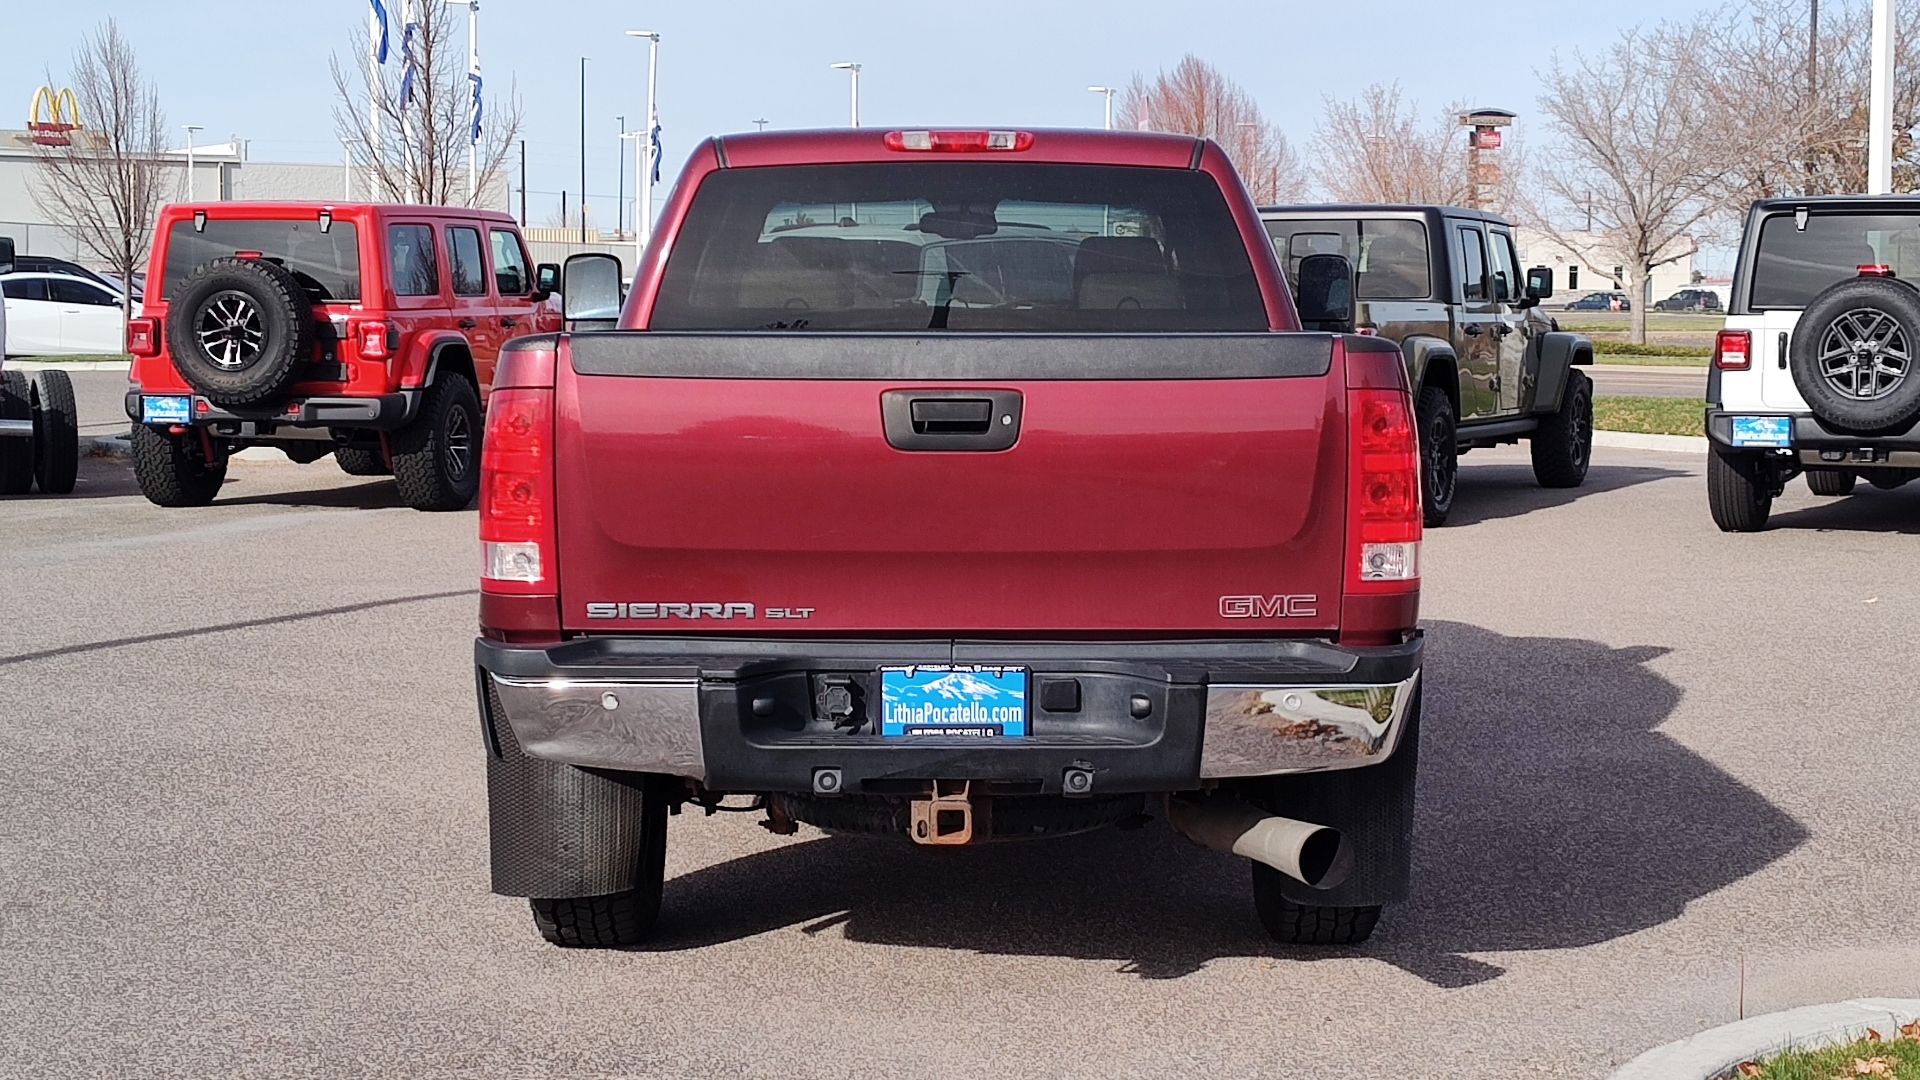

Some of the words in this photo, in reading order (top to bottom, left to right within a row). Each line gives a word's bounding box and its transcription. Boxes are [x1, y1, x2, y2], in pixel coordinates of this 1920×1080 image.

[586, 602, 755, 619] SIERRA
[765, 607, 815, 619] SLT
[1219, 594, 1317, 618] GMC
[885, 702, 1022, 724] LithiaPocatello.com
